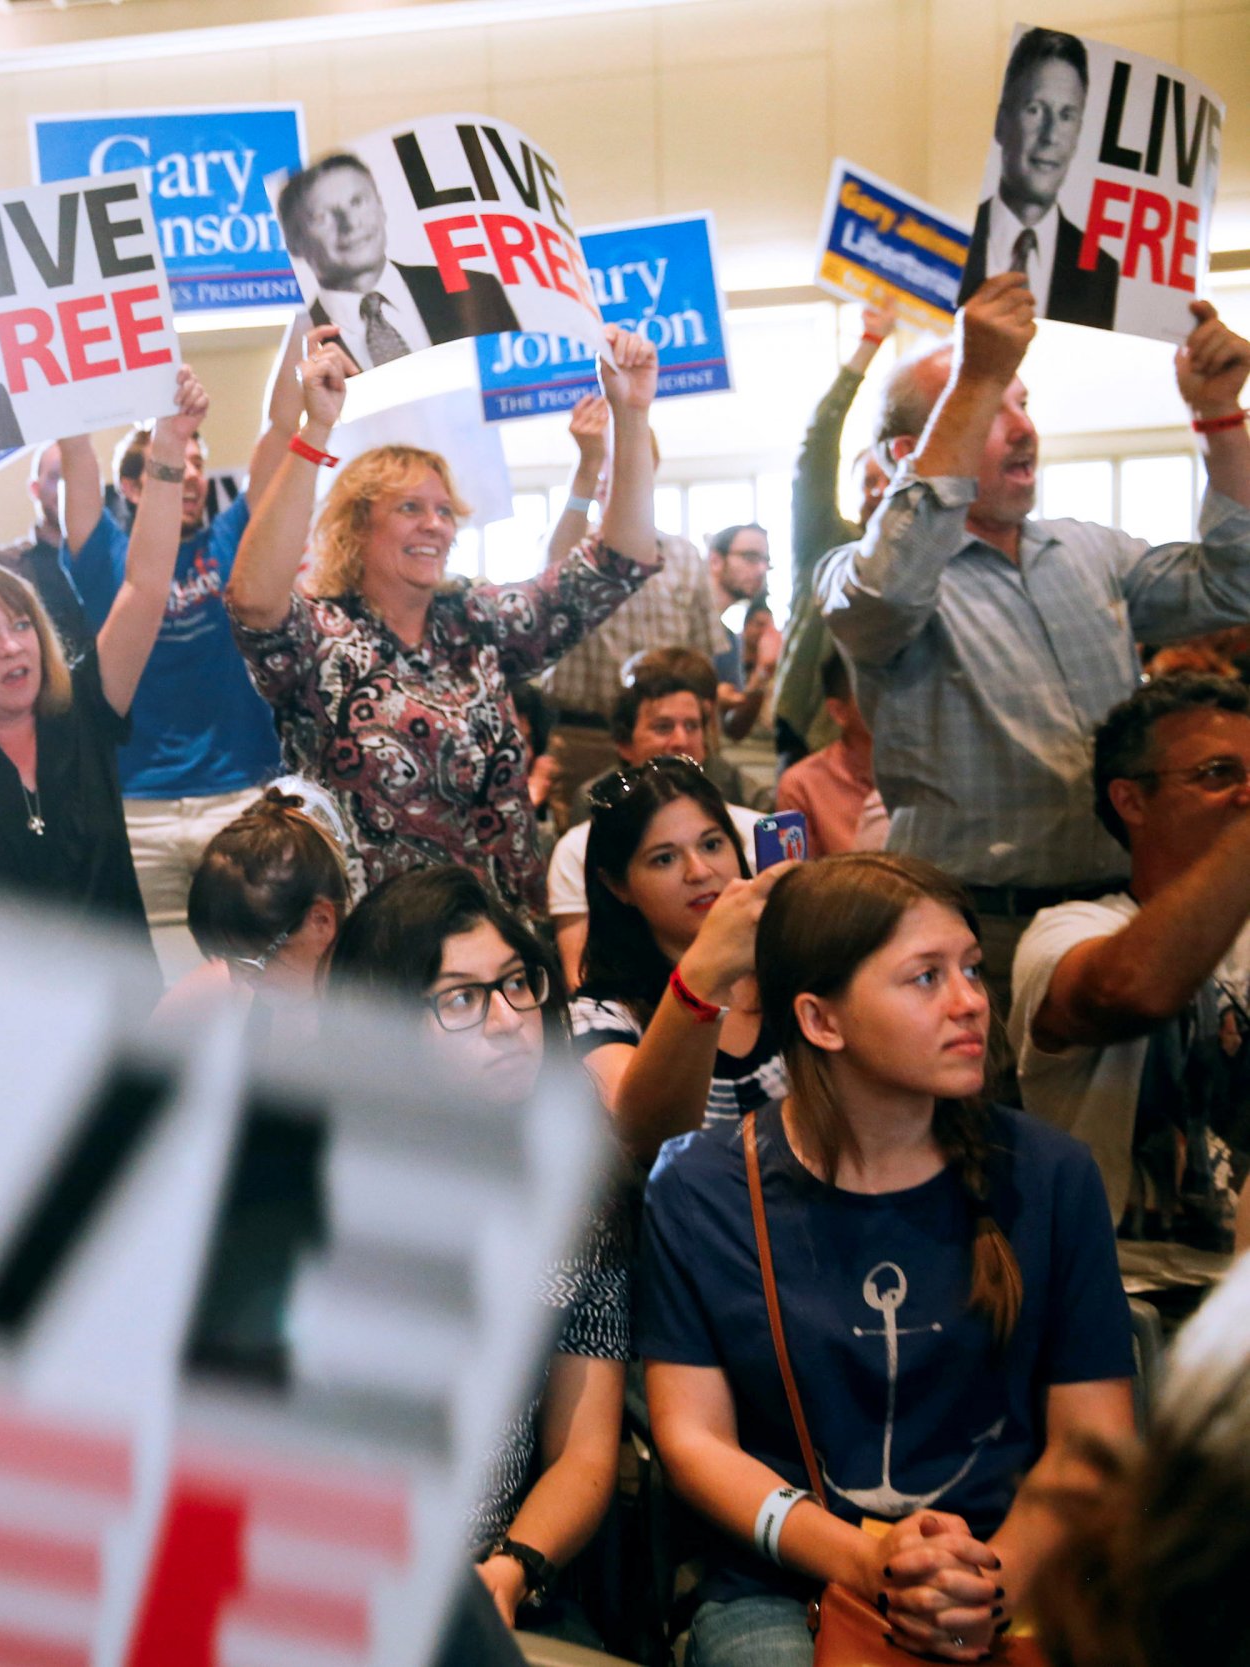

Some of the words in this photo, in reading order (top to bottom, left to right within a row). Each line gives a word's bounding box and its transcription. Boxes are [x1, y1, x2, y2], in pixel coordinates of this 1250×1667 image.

[89, 135, 257, 212] Gary
[393, 124, 576, 240] LIVE
[159, 212, 287, 258] nson
[423, 213, 605, 322] FREE
[1077, 178, 1199, 294] FRE
[197, 279, 298, 302] PRESIDENT
[588, 257, 668, 315] ary
[491, 308, 710, 374] Johon
